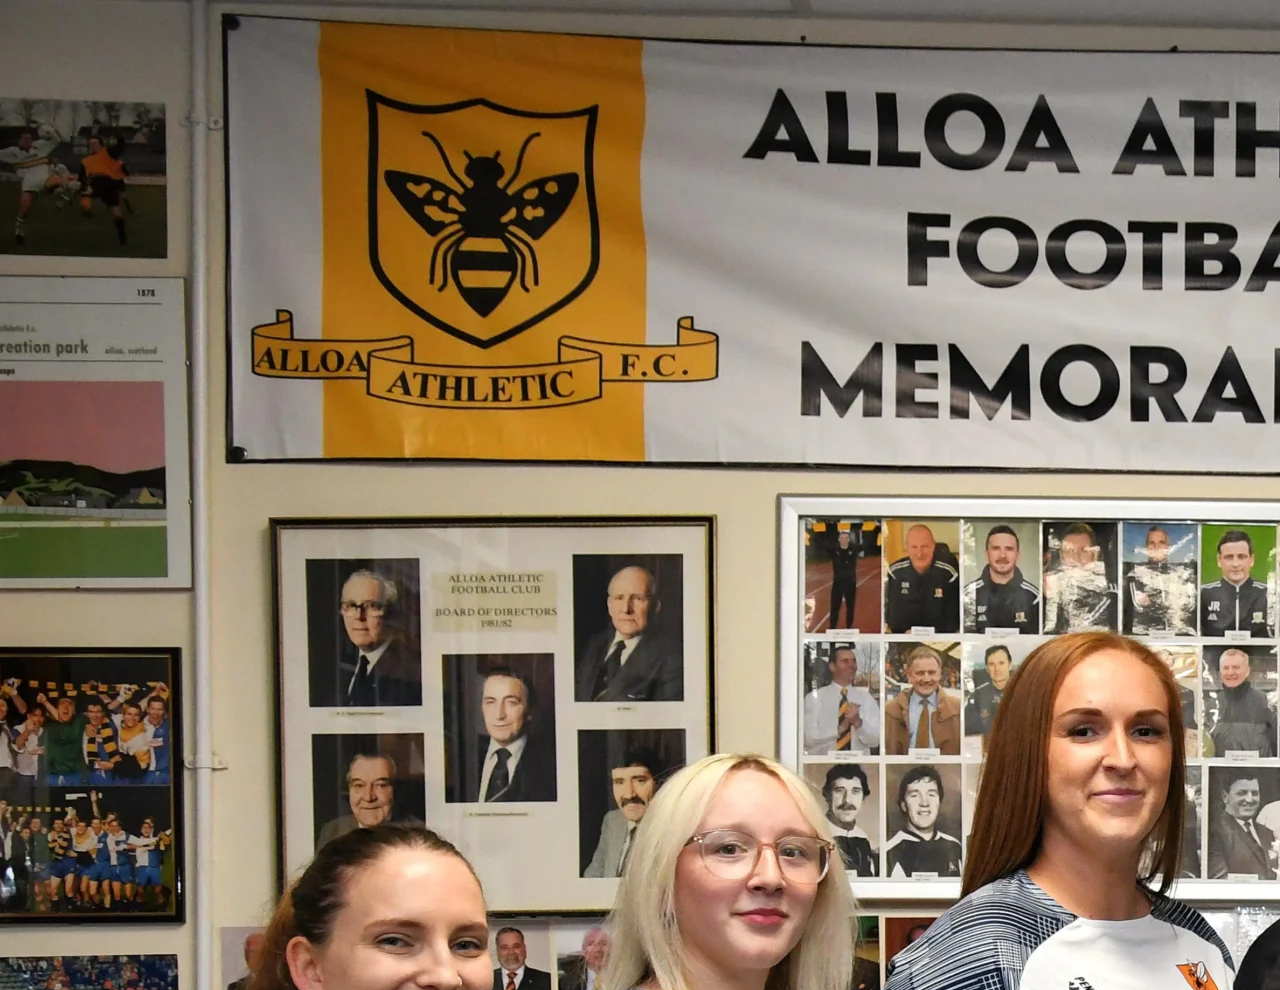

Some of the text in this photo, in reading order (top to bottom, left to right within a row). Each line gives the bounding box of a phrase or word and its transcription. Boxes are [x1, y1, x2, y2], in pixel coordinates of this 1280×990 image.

[743, 87, 1079, 174] ALLOA
[137, 289, 155, 297] 1878
[56, 339, 88, 357] park
[255, 346, 688, 402] ALLOA ATHLETIC F.C.
[448, 574, 543, 583] ALLOA ATHLETIC
[451, 585, 541, 594] FOOTBALL CLUB
[1208, 600, 1220, 612] JR
[435, 607, 557, 617] BOARD OF DIRECTORS
